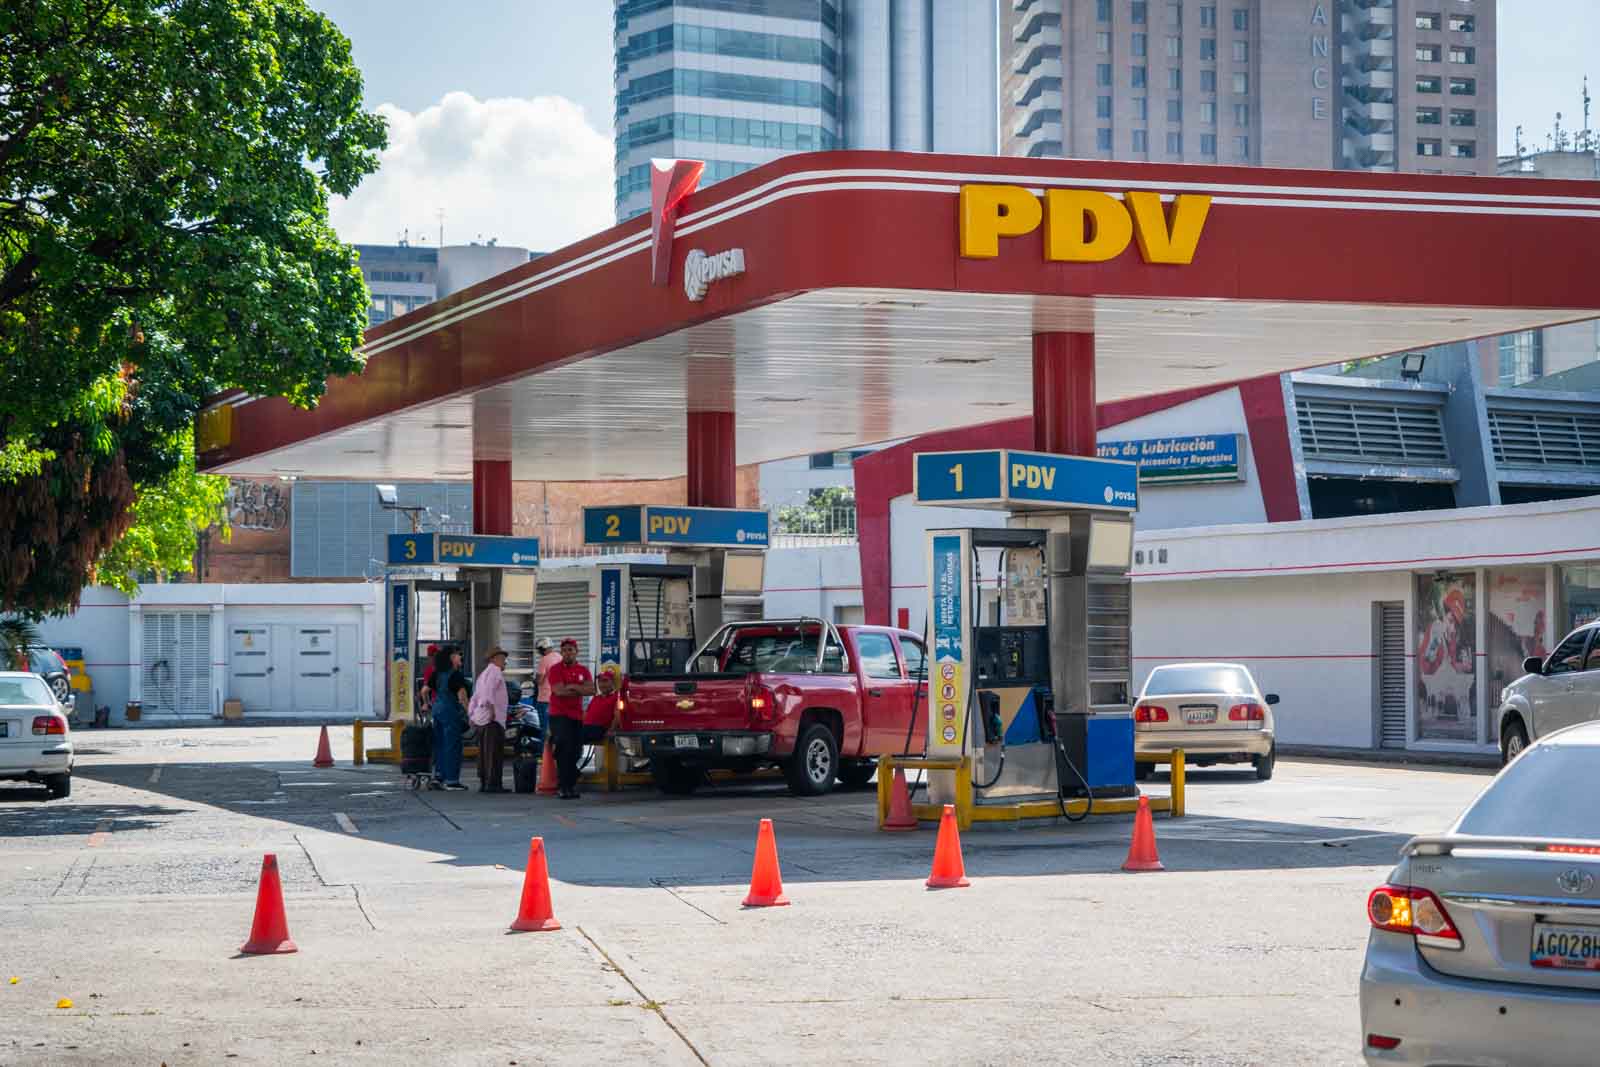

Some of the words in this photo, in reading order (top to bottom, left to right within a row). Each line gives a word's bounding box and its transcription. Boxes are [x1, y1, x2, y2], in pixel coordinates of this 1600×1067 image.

[959, 183, 1213, 265] PDV
[702, 248, 745, 282] PDVSA
[1097, 443, 1119, 457] tro
[1123, 442, 1138, 456] de
[949, 463, 964, 493] 1
[1011, 463, 1057, 490] PDV
[606, 515, 621, 537] 2
[649, 515, 692, 535] PDV
[404, 539, 417, 560] 3
[440, 542, 476, 557] PDV
